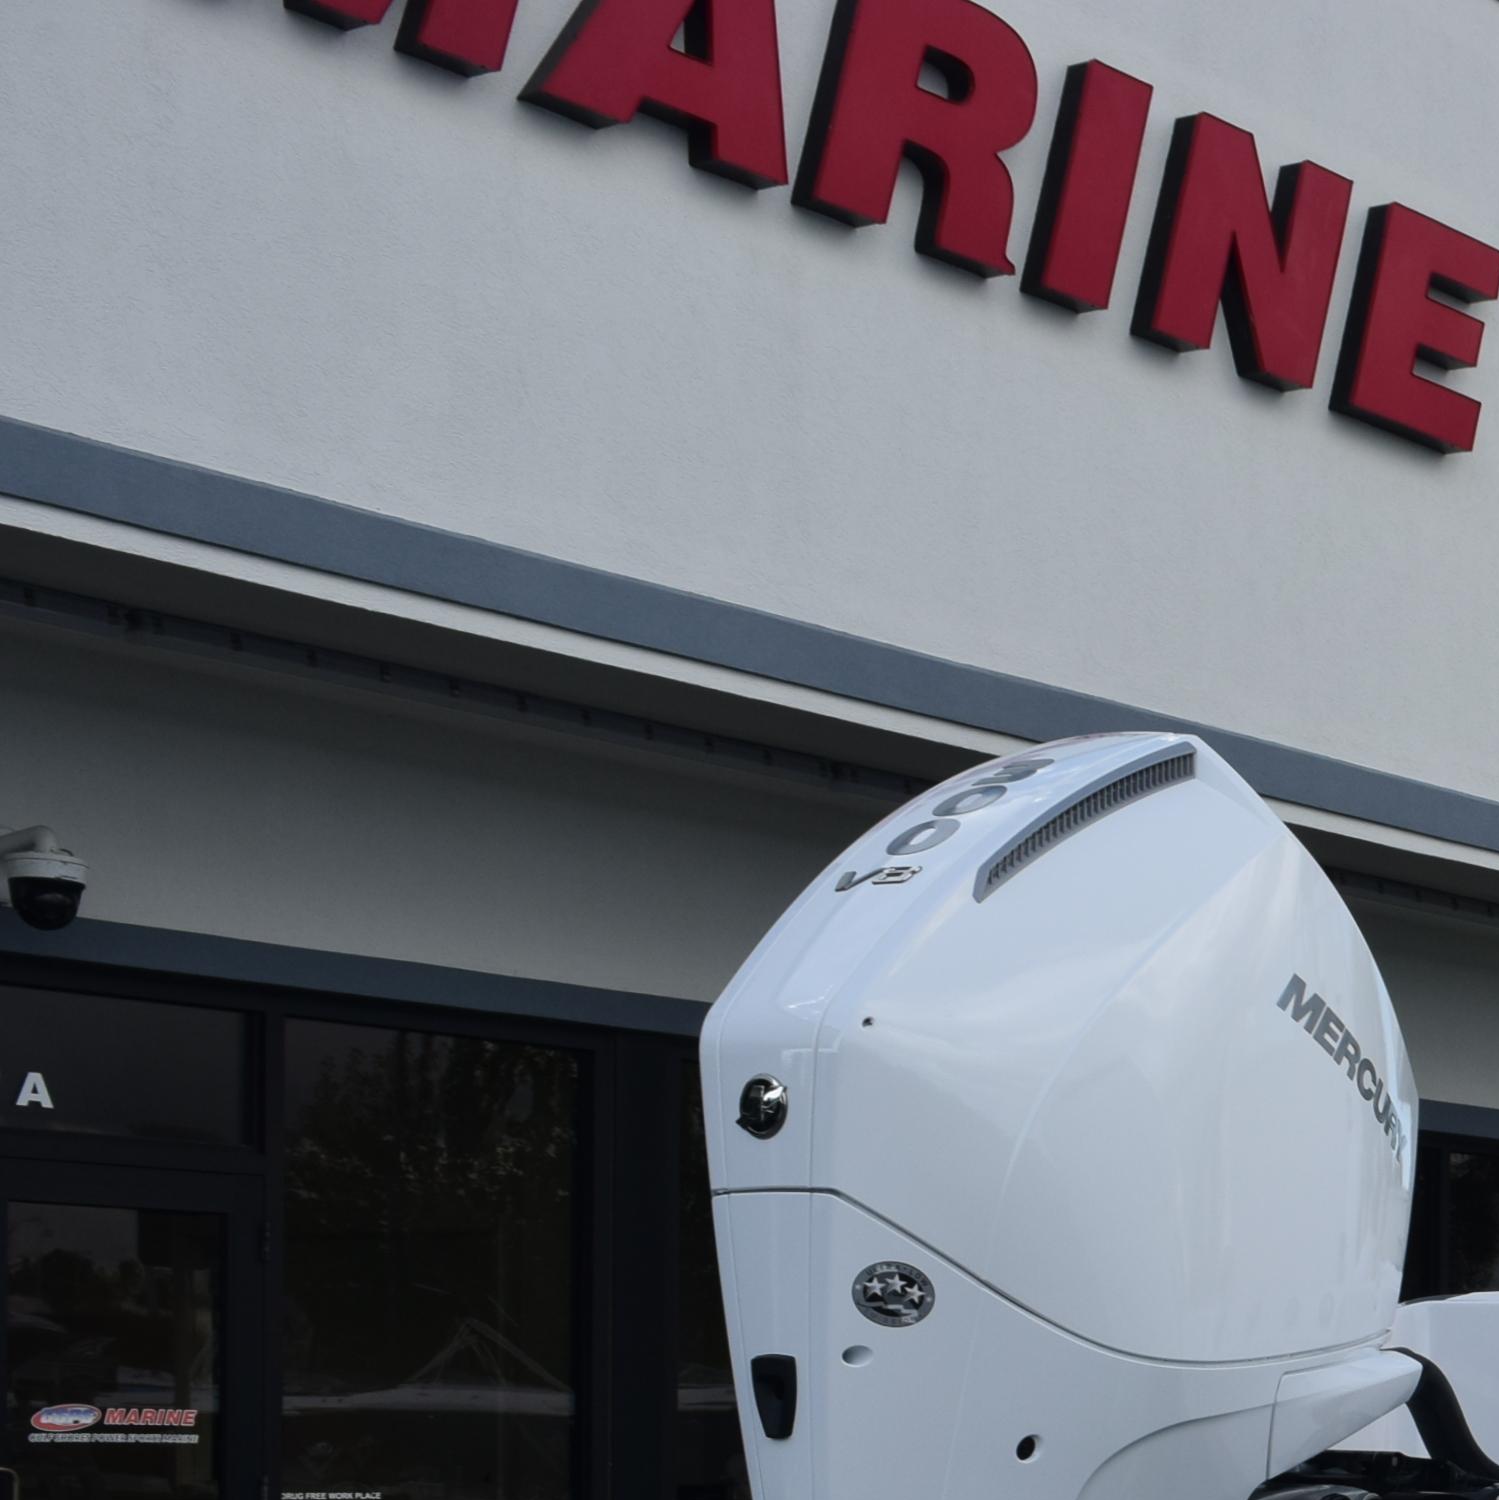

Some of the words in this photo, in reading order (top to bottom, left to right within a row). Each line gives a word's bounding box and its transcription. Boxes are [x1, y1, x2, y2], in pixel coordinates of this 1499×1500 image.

[886, 758, 1055, 856] 300
[834, 864, 923, 893] V8
[1276, 973, 1407, 1164] MERCURY
[15, 1071, 55, 1109] A
[104, 1407, 198, 1427] MARINE
[281, 1492, 304, 1500] DRUG
[305, 1492, 327, 1500] FREE
[328, 1492, 353, 1500] WORK
[355, 1491, 381, 1500] PLACE
